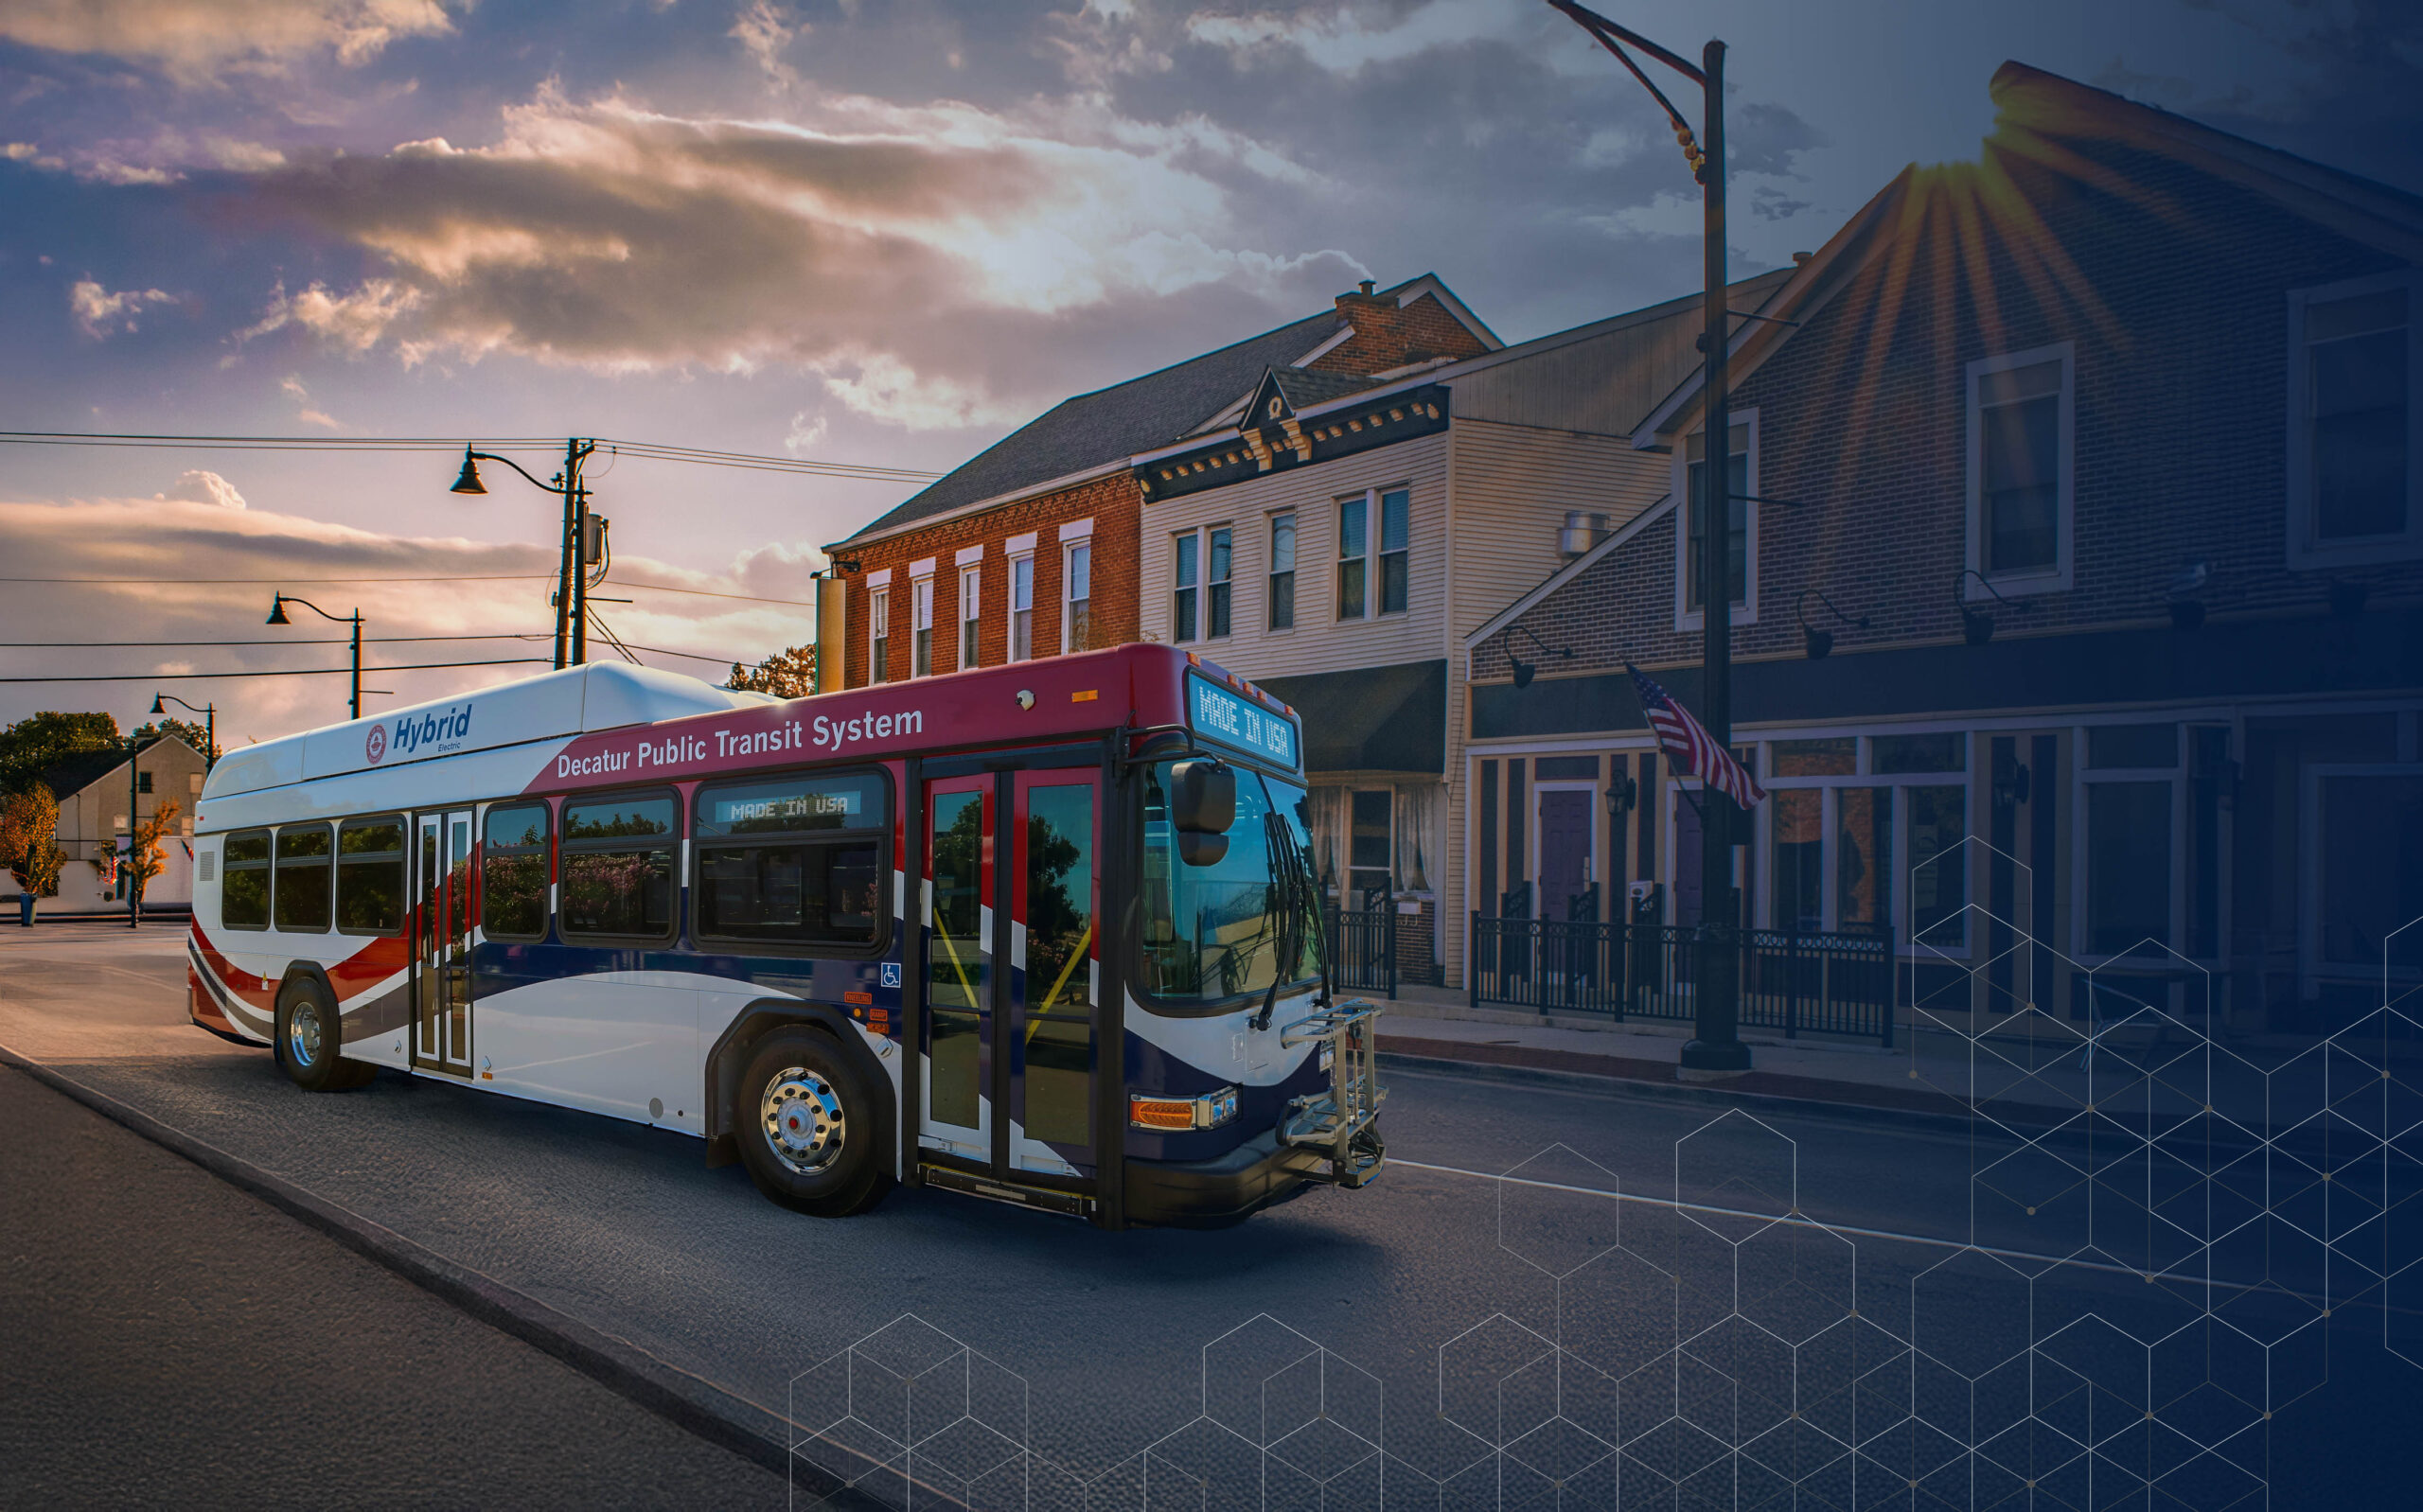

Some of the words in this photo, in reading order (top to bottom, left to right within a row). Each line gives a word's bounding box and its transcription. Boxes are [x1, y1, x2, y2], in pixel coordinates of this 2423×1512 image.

[393, 703, 473, 754] Hybrid
[437, 742, 461, 752] Electric
[557, 749, 631, 778] Decatur
[638, 734, 706, 768] Public
[716, 720, 803, 757] Transit
[812, 711, 922, 751] System
[1199, 686, 1240, 736] MADE
[1244, 708, 1262, 745] IN
[1265, 718, 1289, 757] USA
[731, 801, 776, 820] MADE
[785, 800, 807, 816] IN
[817, 797, 848, 814] USA
